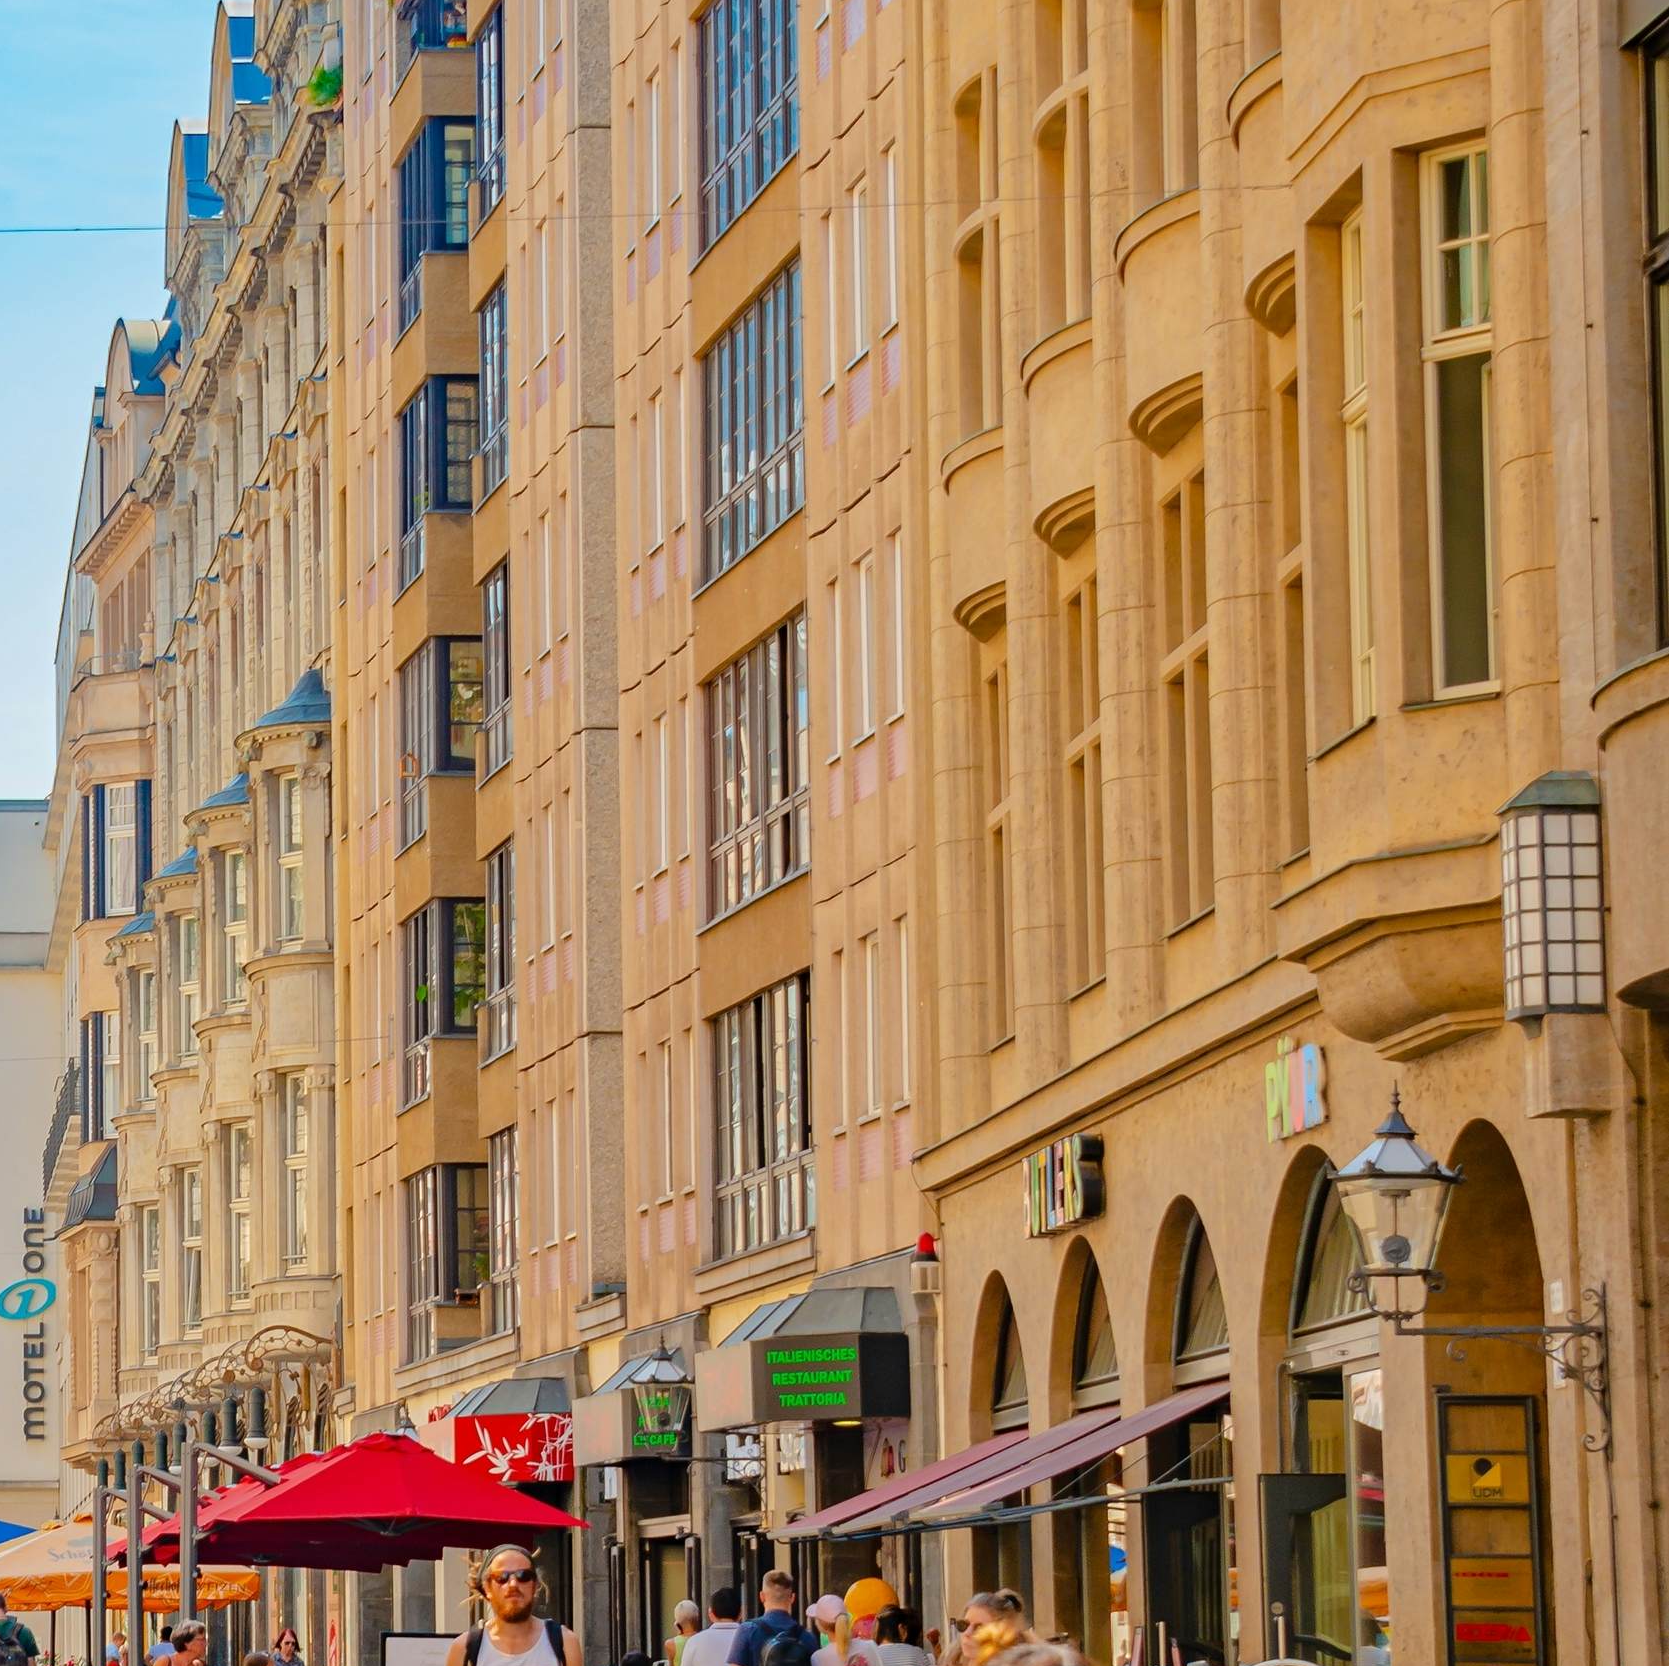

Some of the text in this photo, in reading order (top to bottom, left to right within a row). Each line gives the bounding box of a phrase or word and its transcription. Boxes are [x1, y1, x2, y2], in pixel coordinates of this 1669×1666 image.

[22, 1207, 45, 1274] ONE
[766, 1347, 857, 1364] ITALIENISCHES
[23, 1322, 45, 1441] MOTEL
[772, 1369, 853, 1385] RESTAURANT
[779, 1392, 847, 1407] TRATTORIA
